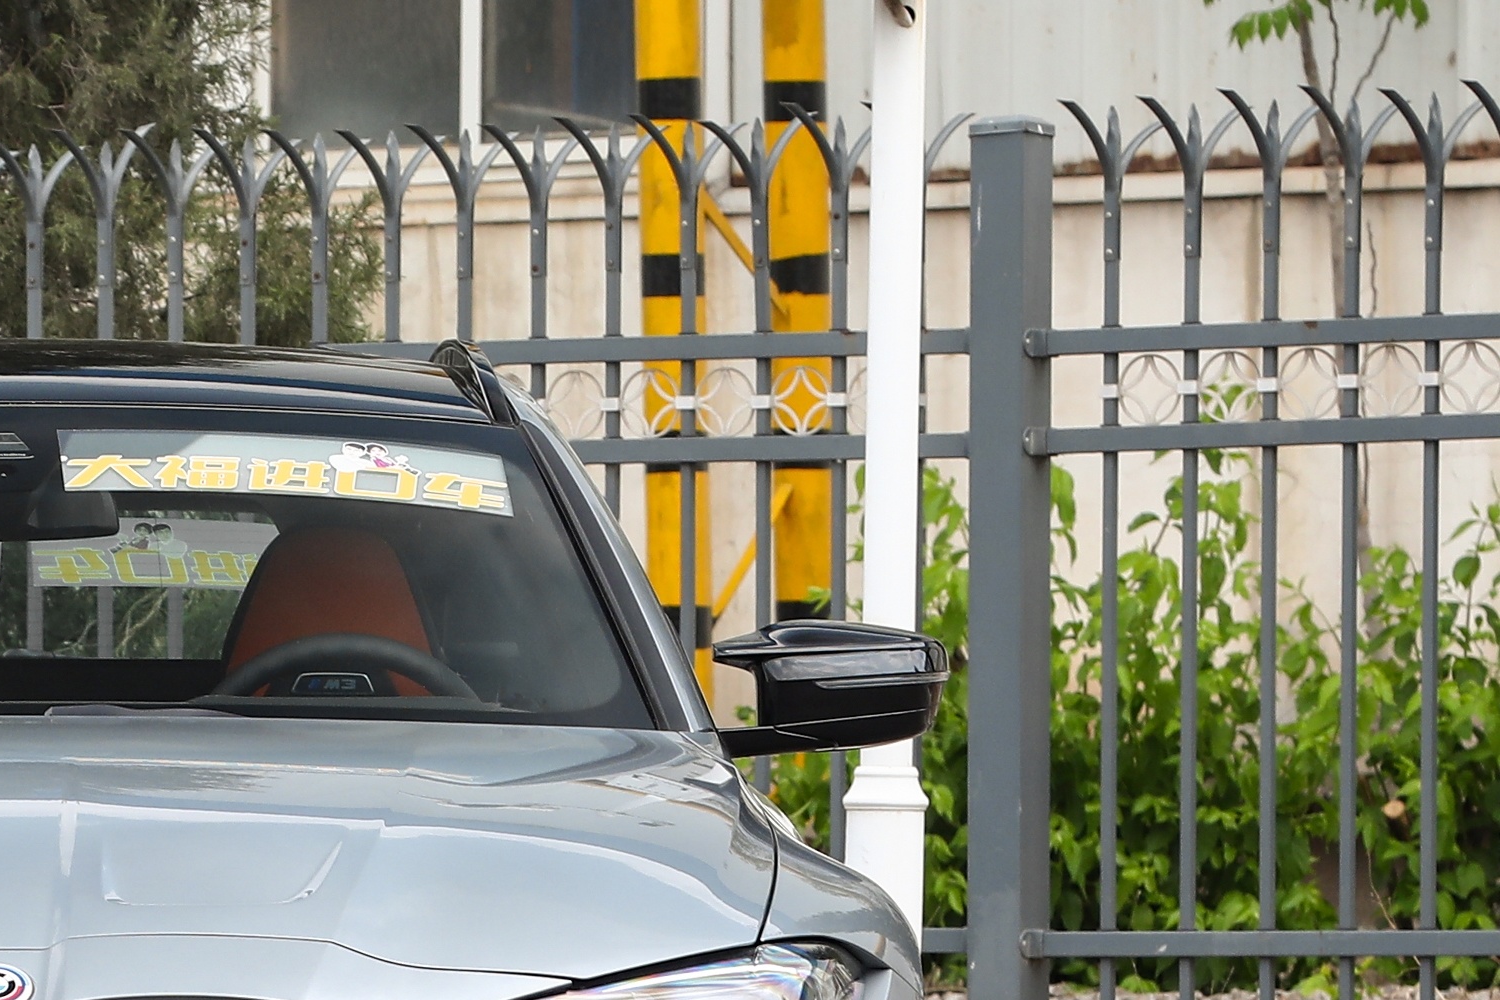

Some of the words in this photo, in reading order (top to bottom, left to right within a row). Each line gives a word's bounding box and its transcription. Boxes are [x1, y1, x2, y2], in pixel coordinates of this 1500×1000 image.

[64, 454, 507, 509] 大福进口车
